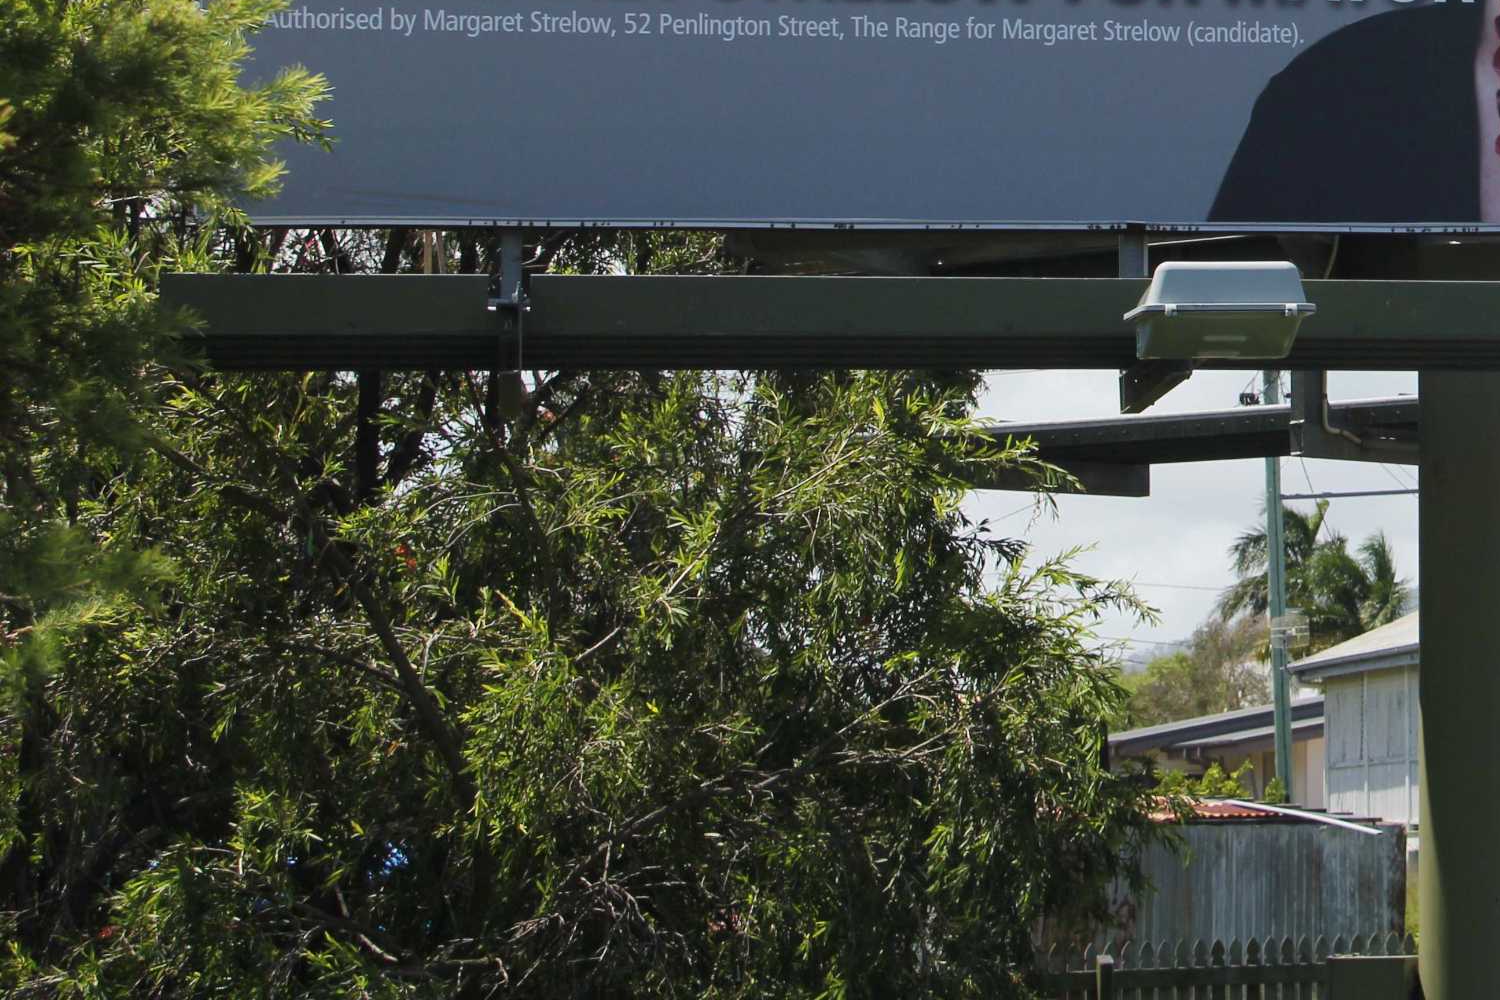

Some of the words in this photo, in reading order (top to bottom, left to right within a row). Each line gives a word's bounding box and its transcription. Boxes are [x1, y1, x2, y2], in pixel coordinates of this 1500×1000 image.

[265, 6, 382, 30] Authorised
[391, 8, 416, 36] by
[424, 9, 523, 37] Margaret
[530, 10, 617, 37] Strelow,
[624, 13, 651, 34] 52
[660, 13, 770, 41] Penlington
[778, 15, 844, 40] Street,
[851, 15, 888, 38] The
[896, 17, 960, 44] Range
[966, 17, 996, 39] for
[1003, 18, 1097, 46] Margaret
[1103, 19, 1180, 42] Strelow
[1187, 21, 1305, 48] (candidate).
